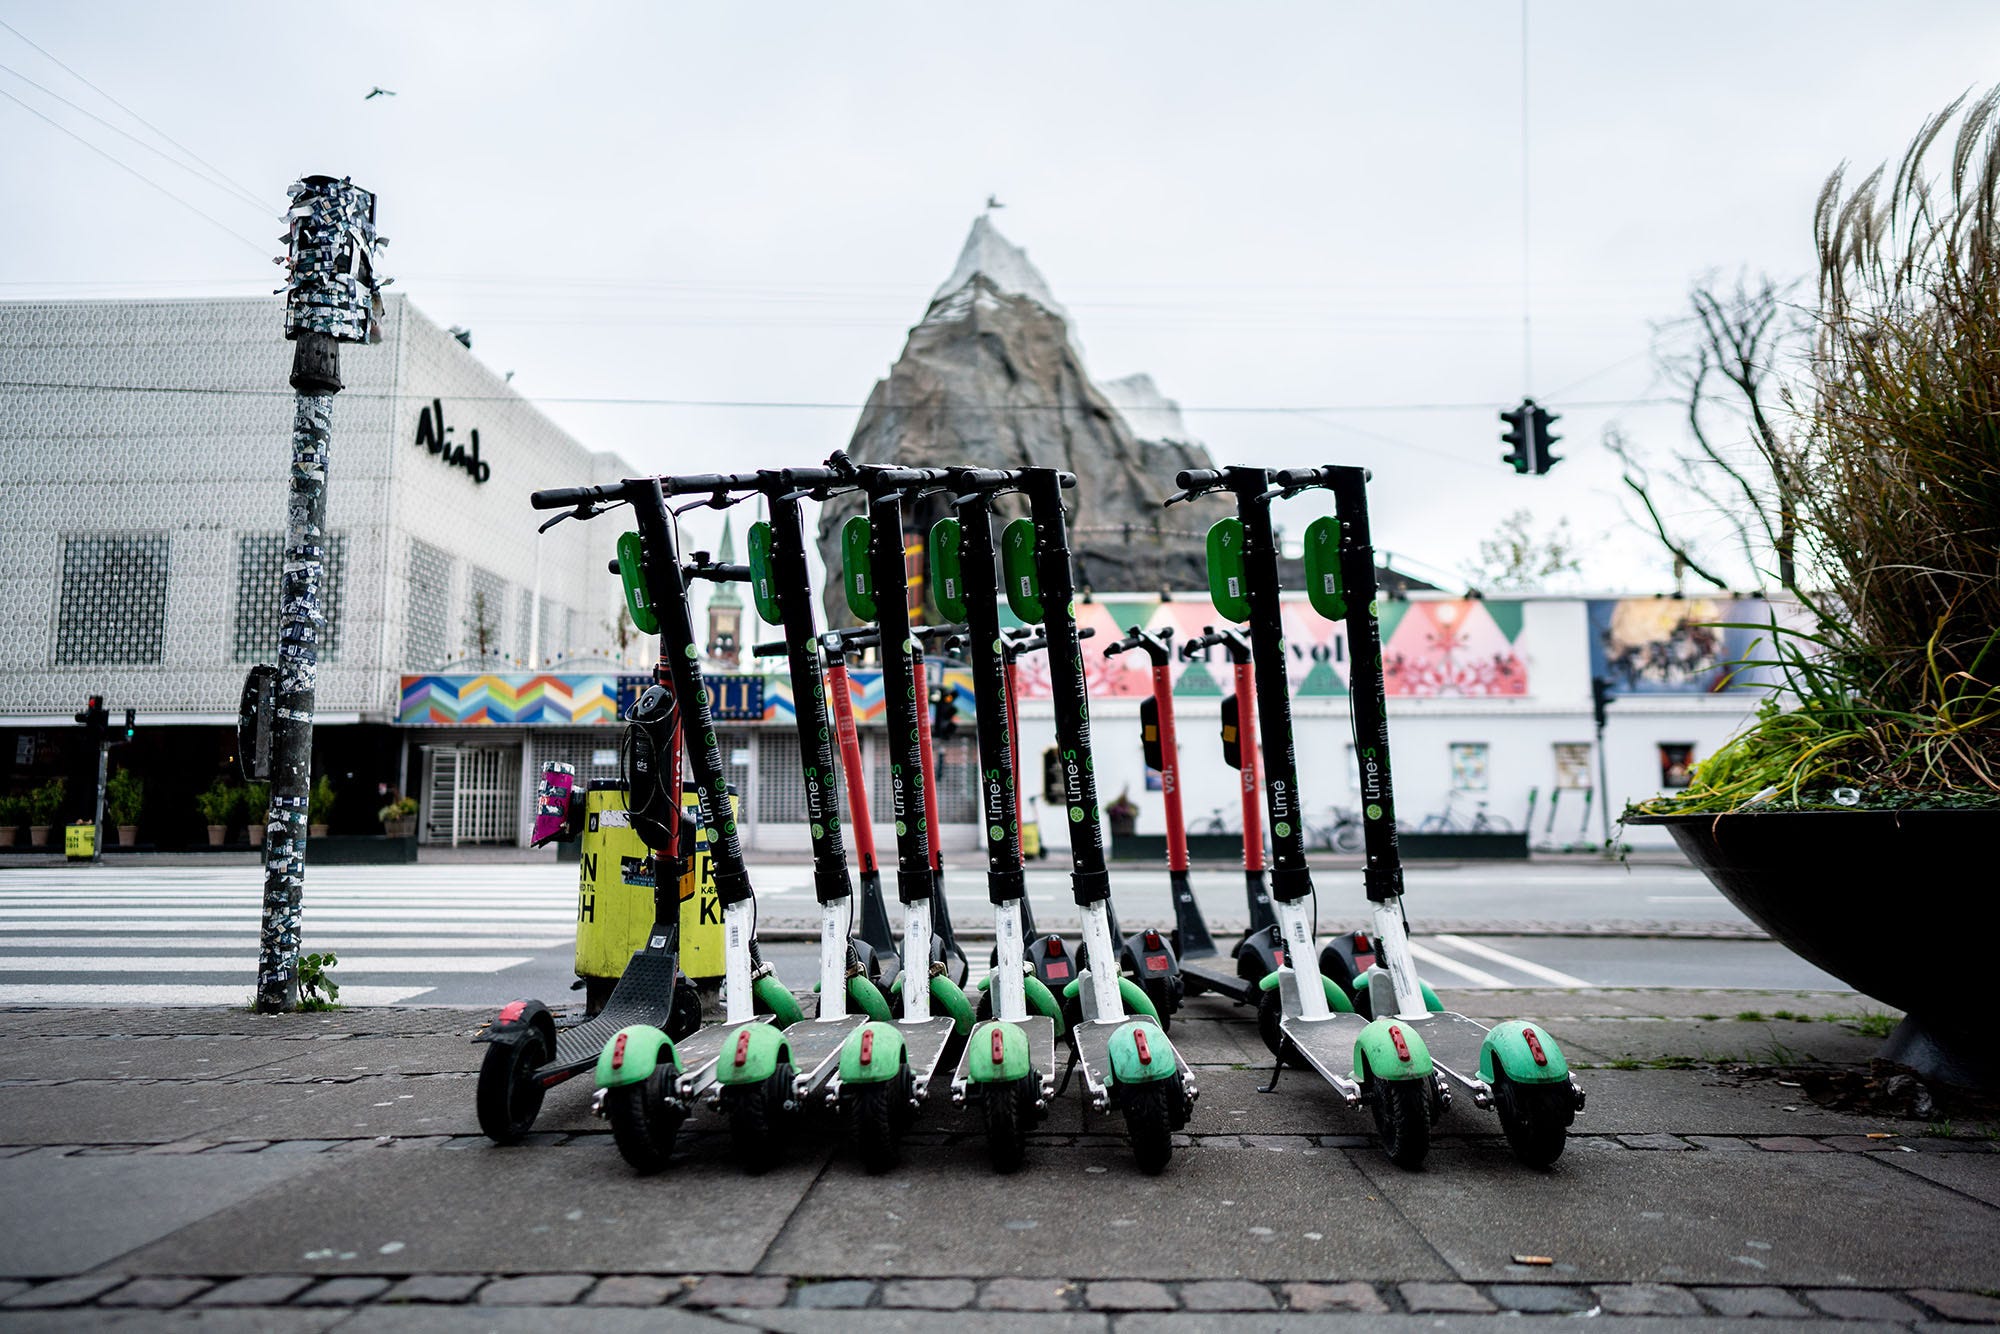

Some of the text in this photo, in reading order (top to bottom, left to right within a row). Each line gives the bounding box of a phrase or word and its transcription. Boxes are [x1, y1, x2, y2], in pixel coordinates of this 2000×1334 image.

[415, 398, 490, 484] Nimb
[626, 683, 749, 711] TLI
[698, 786, 714, 823] Lime
[1273, 780, 1288, 817] Lime
[578, 894, 595, 923] H
